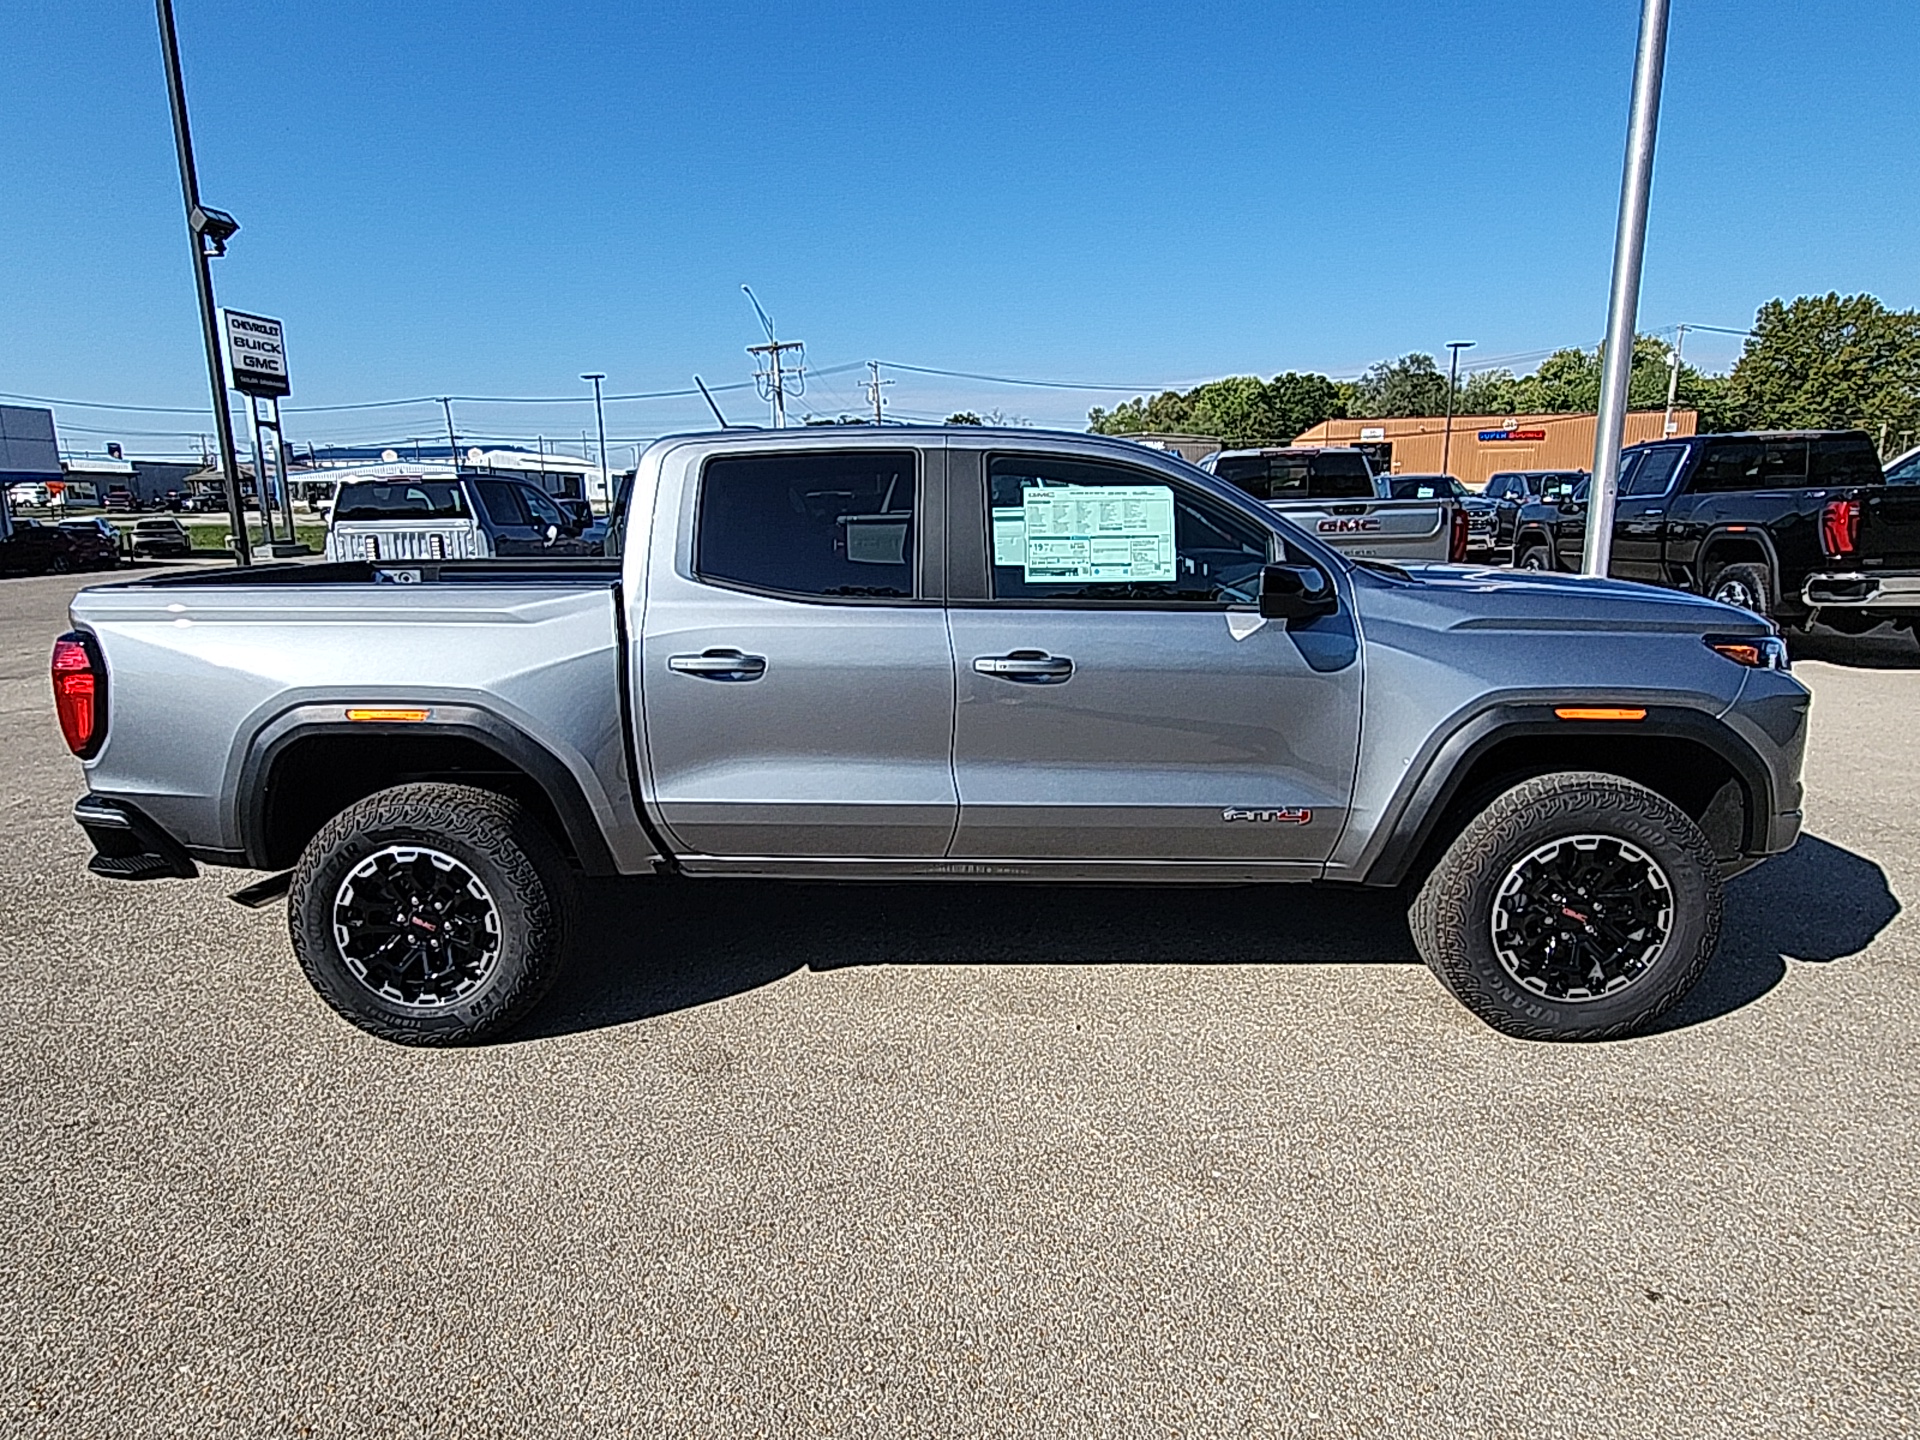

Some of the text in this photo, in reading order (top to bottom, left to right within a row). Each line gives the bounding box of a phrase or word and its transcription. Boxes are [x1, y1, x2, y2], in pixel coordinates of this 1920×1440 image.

[233, 336, 282, 354] BUICK
[243, 355, 279, 371] GMC
[1317, 519, 1381, 532] GMC
